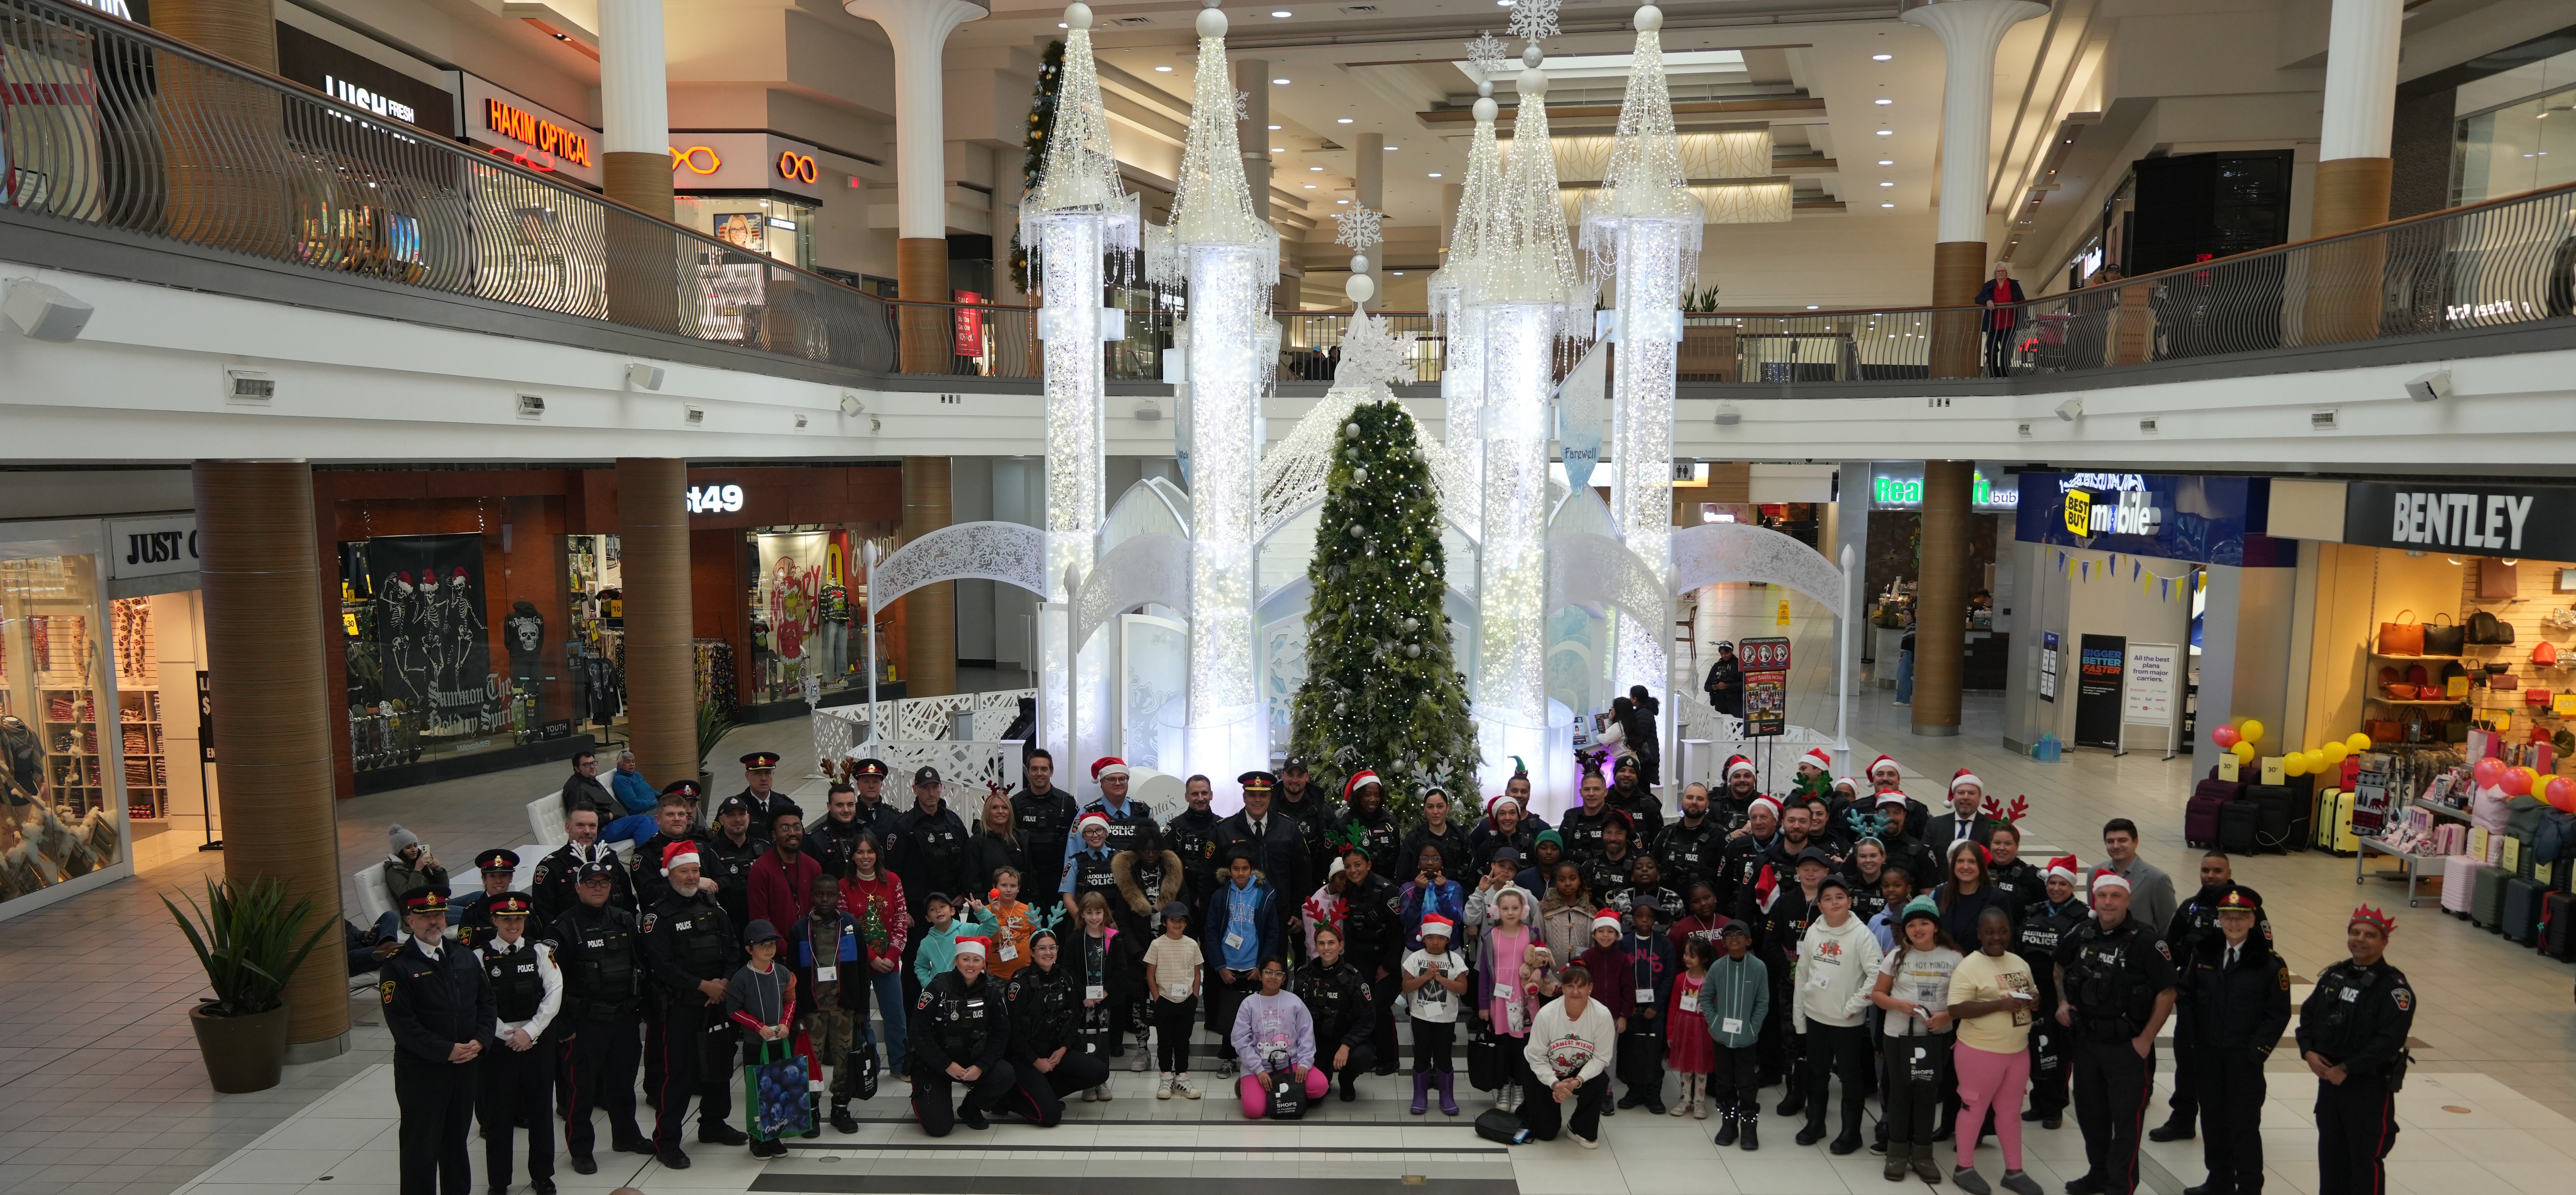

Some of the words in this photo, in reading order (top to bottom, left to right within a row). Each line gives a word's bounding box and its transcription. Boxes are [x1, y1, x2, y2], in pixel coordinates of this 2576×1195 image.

[388, 100, 414, 123] FRESH
[490, 98, 536, 146] HAKIM
[539, 120, 592, 168] OPTICAL
[1565, 447, 1596, 460] Farewell
[2068, 496, 2089, 516] BEST
[2067, 513, 2086, 529] BUY
[2090, 491, 2150, 535] mobile
[2392, 492, 2534, 550] BENTLEY
[127, 531, 182, 565] JUST
[2083, 649, 2122, 659] BIGGER
[2082, 656, 2121, 667] BETTER
[2082, 664, 2121, 674] FASTER
[487, 673, 512, 701] The
[546, 723, 567, 733] YOUTH
[1685, 853, 1699, 862] POLICE
[1610, 874, 1623, 883] POLICE
[1999, 882, 2013, 891] POLICE
[1870, 897, 1885, 906] POLICE
[676, 921, 692, 931] POLICE
[2023, 930, 2058, 939] AUXILIARY
[587, 939, 604, 948] POLICE
[2022, 935, 2058, 946] POLICE
[517, 963, 534, 973] POLICE
[1417, 958, 1451, 969] WEDSDAY
[2040, 1055, 2058, 1064] SHOPS
